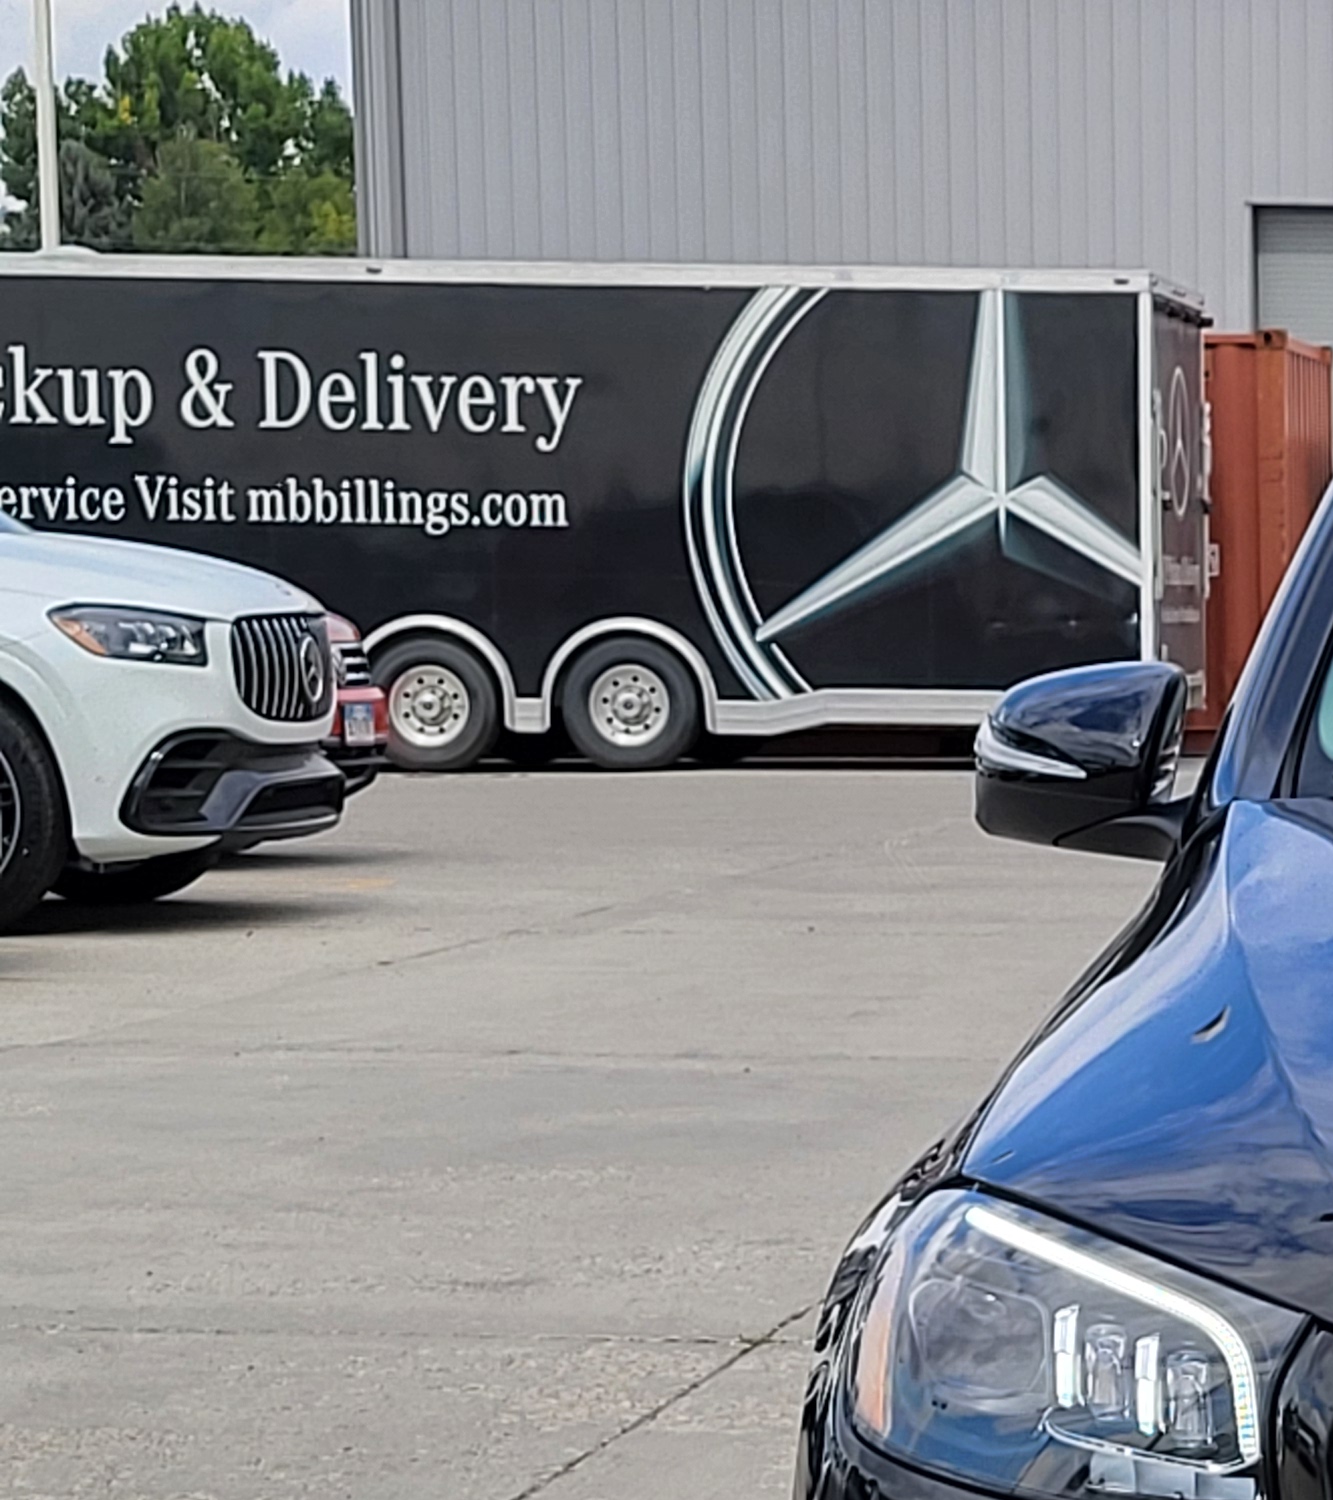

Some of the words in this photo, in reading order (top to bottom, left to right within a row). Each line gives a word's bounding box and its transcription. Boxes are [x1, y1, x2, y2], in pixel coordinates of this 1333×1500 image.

[0, 344, 153, 444] kup
[180, 347, 235, 429] &
[257, 349, 583, 453] Delivery
[134, 474, 237, 523] Visit
[247, 476, 570, 536] mbbillings.com
